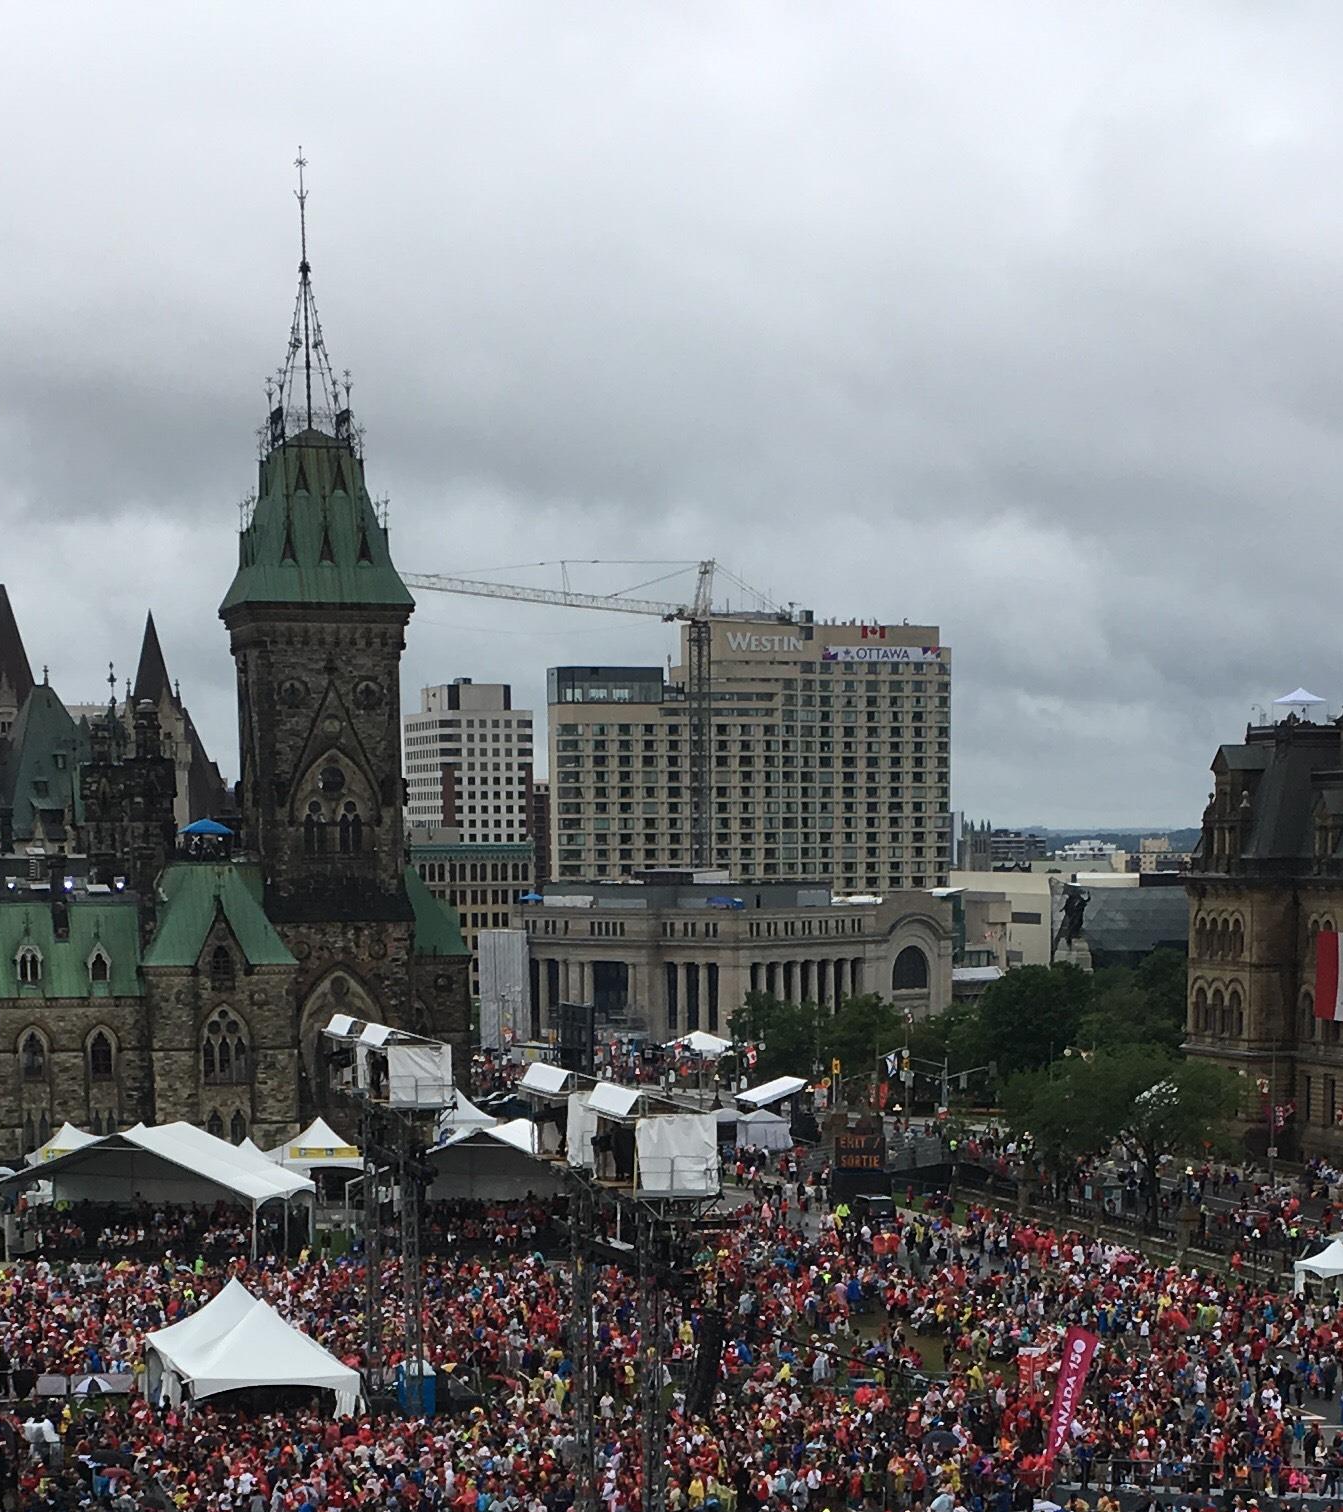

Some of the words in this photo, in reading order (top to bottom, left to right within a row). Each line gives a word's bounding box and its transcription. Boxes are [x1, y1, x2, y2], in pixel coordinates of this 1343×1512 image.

[726, 631, 804, 651] WESTIN
[856, 647, 910, 660] OTTAWA
[840, 1135, 866, 1149] EXIT
[840, 1154, 880, 1168] SORTIE
[1054, 1376, 1077, 1448] CANADA
[1068, 1338, 1087, 1370] 150
